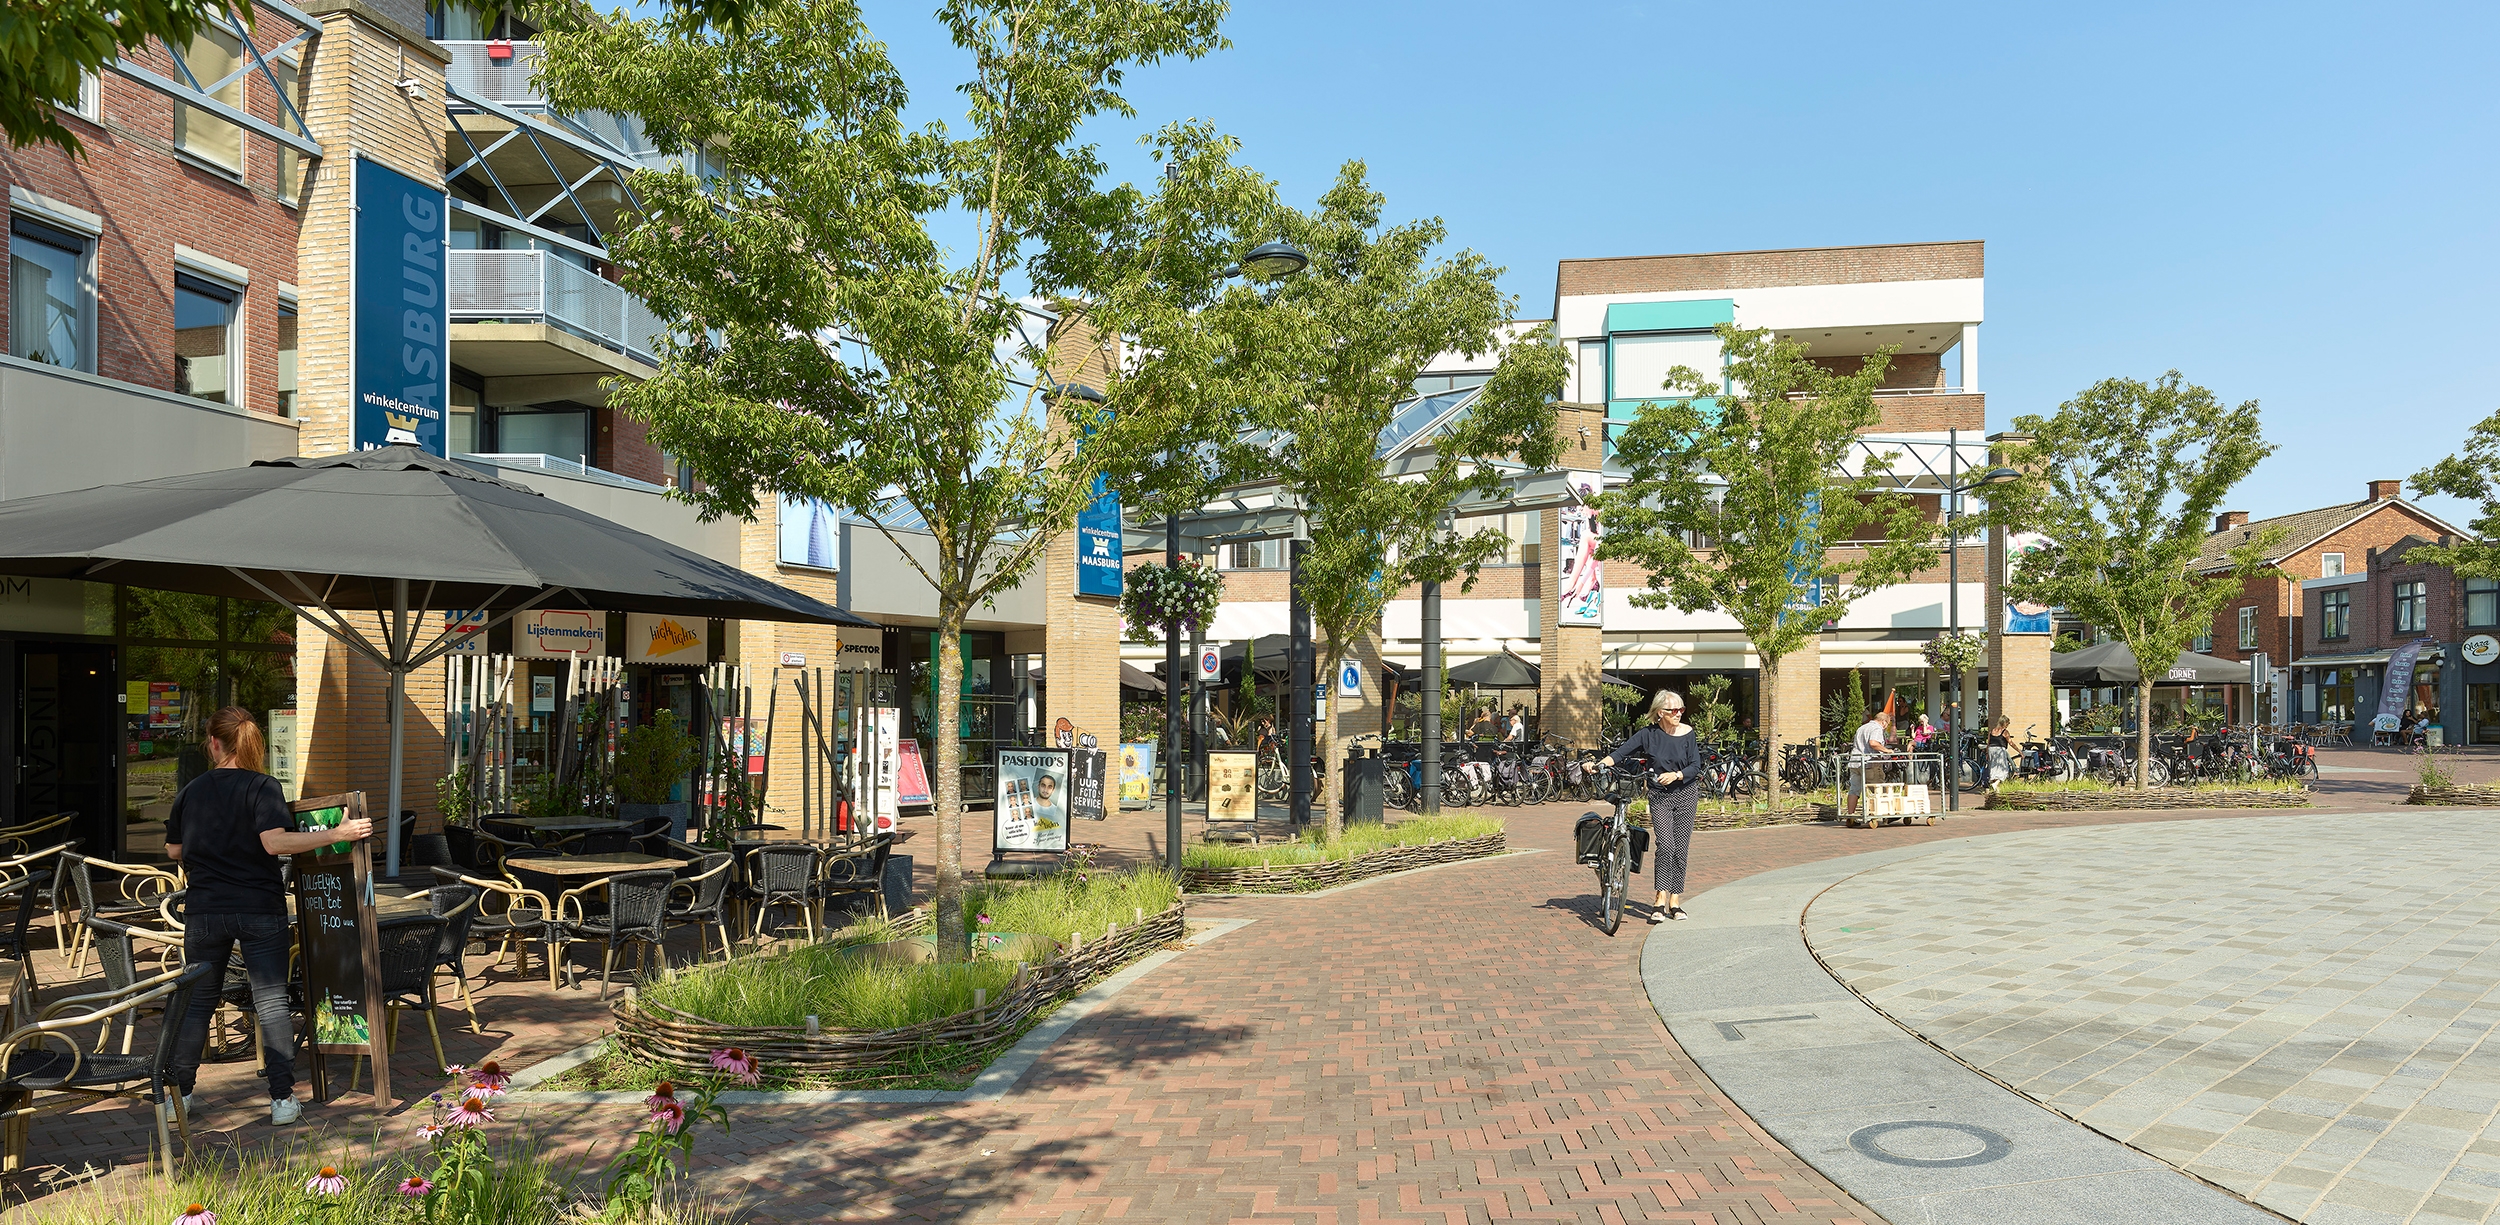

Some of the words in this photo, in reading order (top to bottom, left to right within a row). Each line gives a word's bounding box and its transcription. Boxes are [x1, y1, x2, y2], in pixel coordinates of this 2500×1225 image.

[402, 192, 439, 456] AASBURG
[363, 391, 439, 420] winkelcentrum
[1081, 525, 1119, 540] winkelcentrum
[1081, 554, 1121, 570] MAASBURG
[527, 623, 604, 642] Lijstenmakerij
[844, 644, 880, 654] SPECTOR
[2168, 669, 2197, 680] CORNET
[1001, 755, 1064, 768] PASFOTO'S
[1085, 757, 1093, 779] 1
[1079, 778, 1098, 789] UUR
[1074, 796, 1102, 809] SERVICE
[327, 896, 343, 909] tot
[319, 914, 341, 935] 17.00
